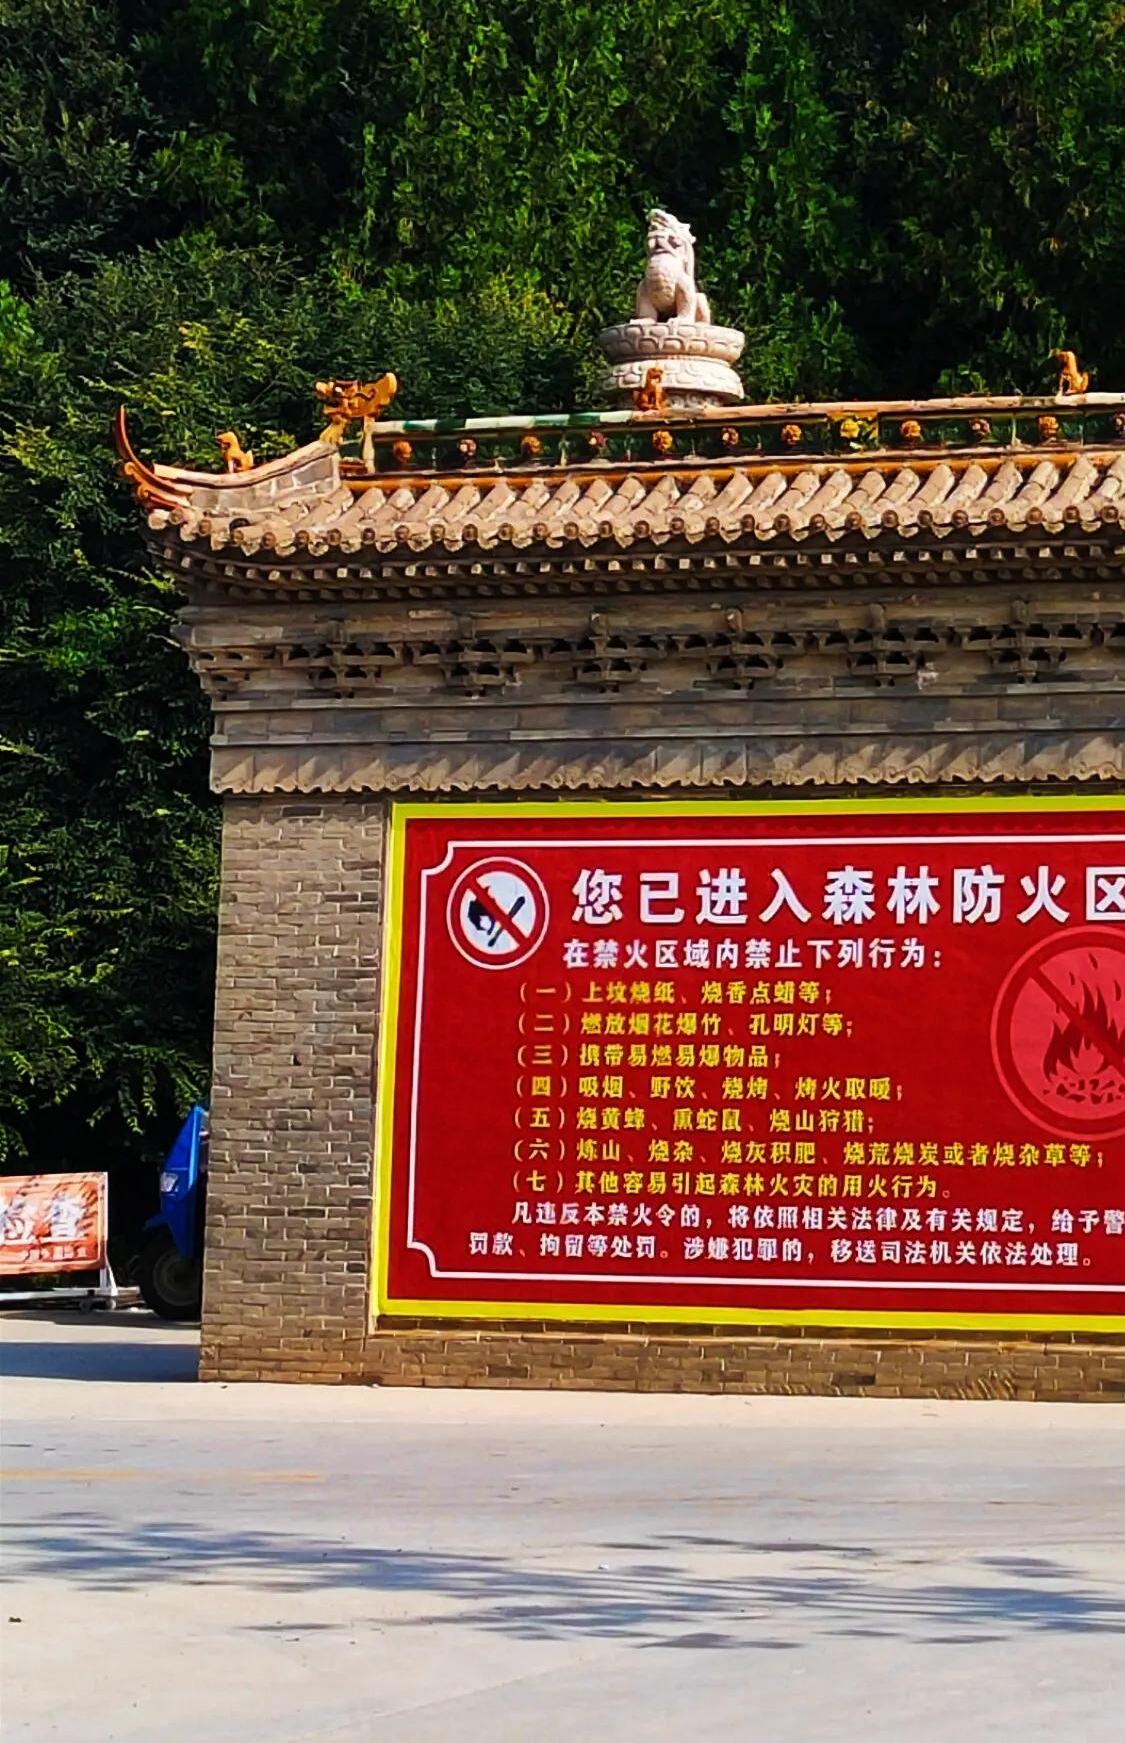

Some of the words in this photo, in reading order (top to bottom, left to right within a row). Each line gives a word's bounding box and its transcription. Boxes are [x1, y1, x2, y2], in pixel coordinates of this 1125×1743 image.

[562, 937, 941, 970] 在禁火区域内禁止下列行为：
